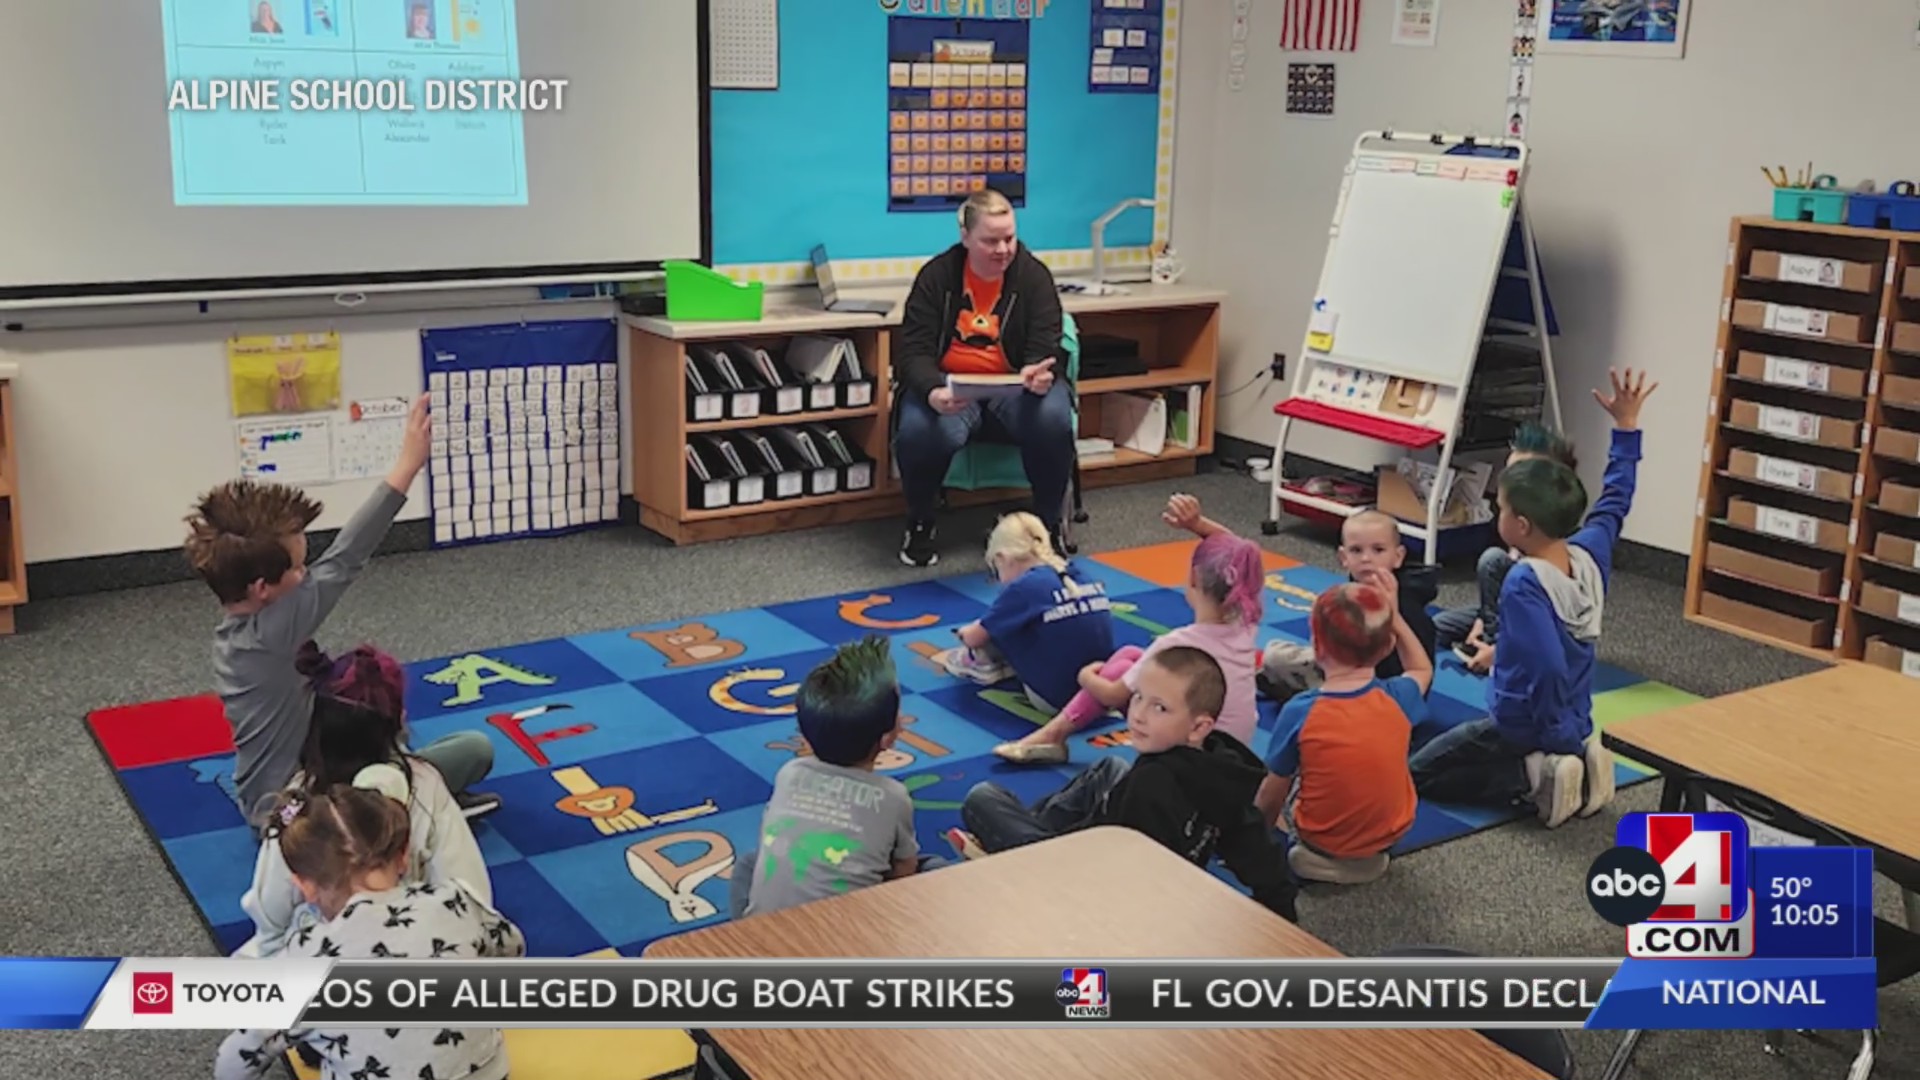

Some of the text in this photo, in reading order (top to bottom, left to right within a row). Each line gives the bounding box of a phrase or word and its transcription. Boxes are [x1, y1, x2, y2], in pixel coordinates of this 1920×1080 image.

[837, 594, 942, 630] C
[628, 622, 748, 669] B
[422, 653, 558, 708] A
[485, 703, 597, 767] F
